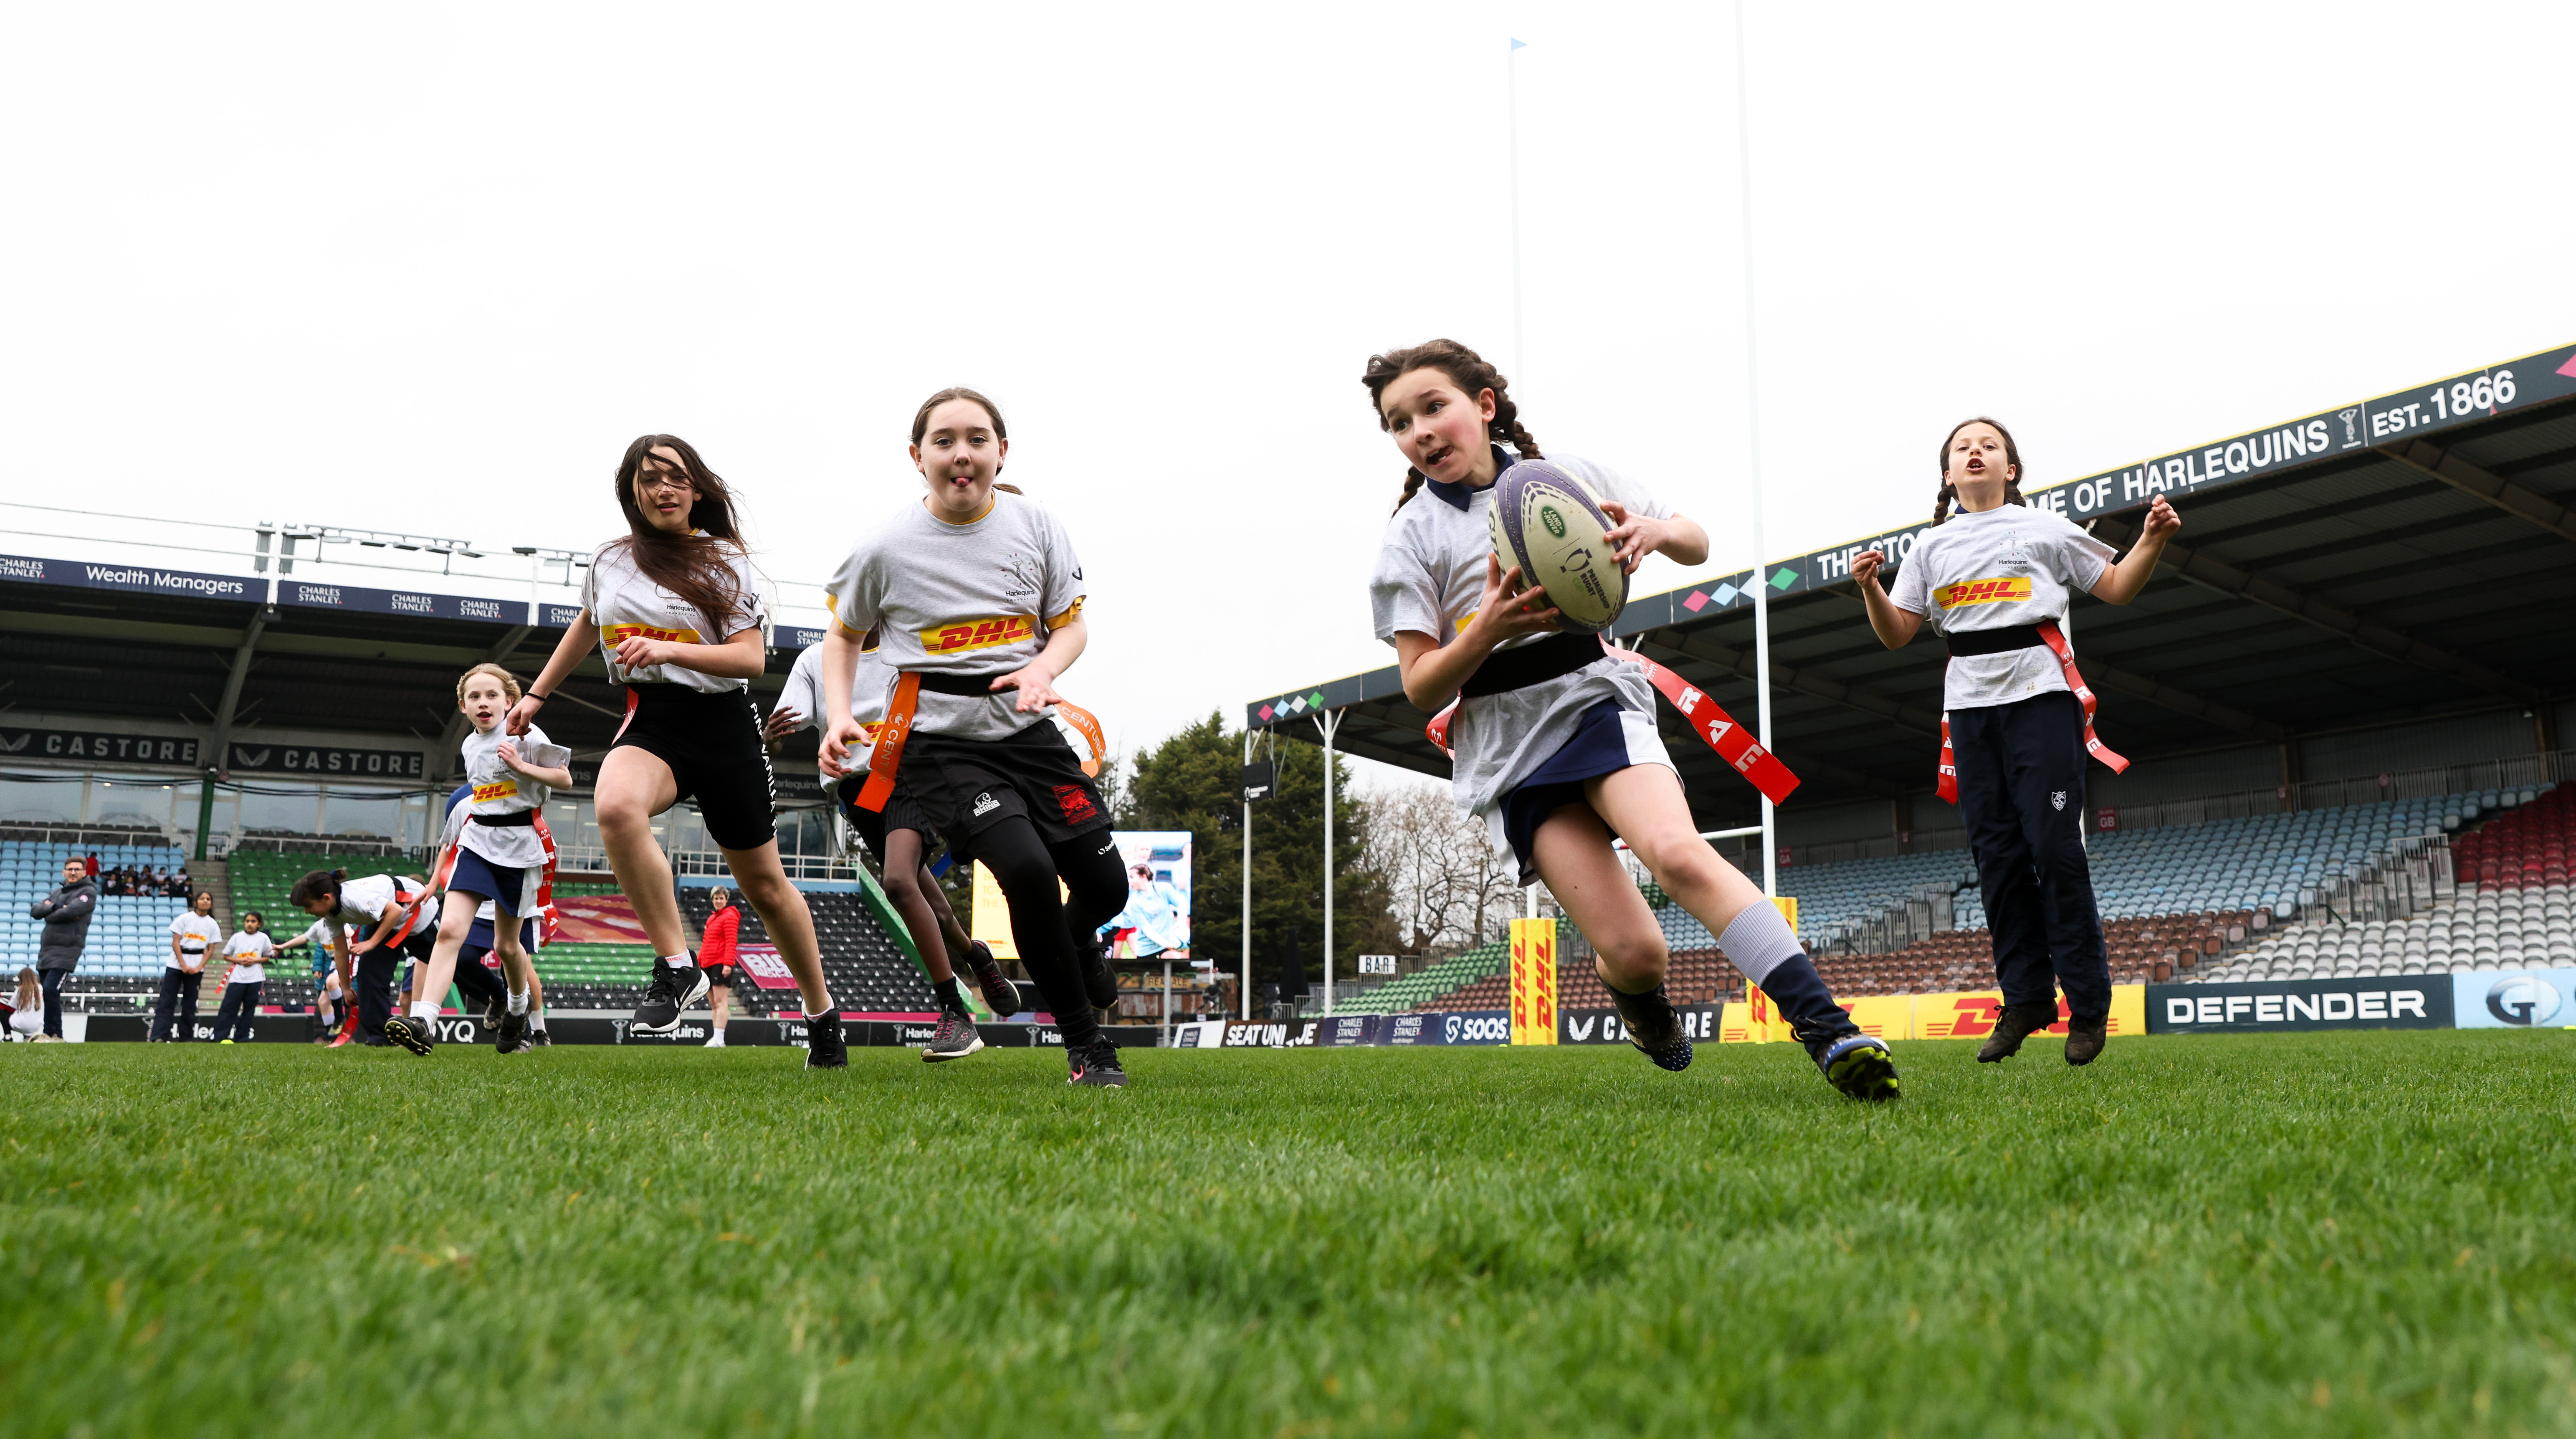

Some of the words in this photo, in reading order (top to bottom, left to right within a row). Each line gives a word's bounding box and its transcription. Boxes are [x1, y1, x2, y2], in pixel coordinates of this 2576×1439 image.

[2074, 476, 2112, 513] OF
[2123, 420, 2329, 501] HARLEQUINS
[1544, 514, 1560, 534] ROVER
[1549, 510, 1562, 527] LAND
[86, 565, 149, 585] Wealth
[154, 572, 243, 595] Managers
[299, 585, 340, 597] CHARLES
[1580, 573, 1596, 597] RUGBY
[1587, 568, 1610, 609] PREMIERSHIP
[392, 594, 432, 604] CHARLES
[1948, 581, 2017, 605] DHL
[460, 600, 500, 610] CHARLES
[939, 617, 1024, 650] DHL
[46, 734, 196, 761] CASTORE
[284, 750, 421, 774] CASTORE
[974, 800, 1000, 816] RHINO
[1366, 957, 1389, 973] BAR
[1514, 937, 1527, 1029] DHL
[1536, 937, 1552, 1029] DHL
[2167, 990, 2427, 1023] DEFENDER
[1336, 1028, 1361, 1037] STANLEY
[1338, 1017, 1364, 1028] CHARLES
[1393, 1027, 1421, 1037] STANLEY
[1395, 1016, 1422, 1027] CHARLES
[1226, 1024, 1263, 1046] SEAT
